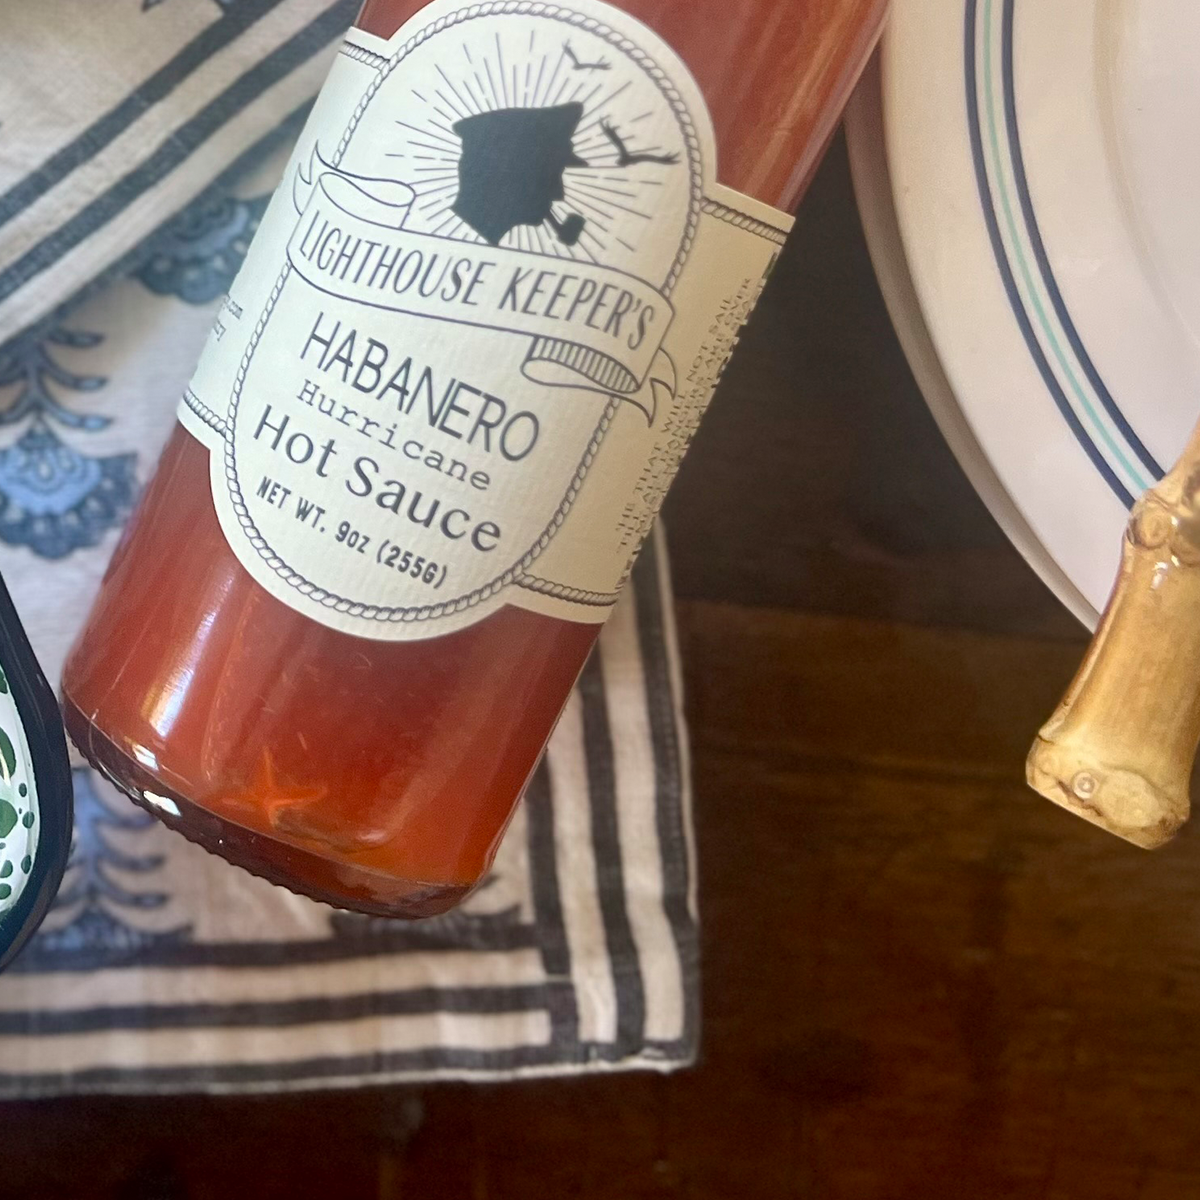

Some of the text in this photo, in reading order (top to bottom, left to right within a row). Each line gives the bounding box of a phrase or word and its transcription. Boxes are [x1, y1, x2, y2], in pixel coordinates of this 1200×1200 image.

[299, 209, 655, 350] LIGHTHOUSE KEEPER'S
[300, 311, 539, 461] HABANERO
[685, 341, 709, 382] NOT
[253, 404, 501, 552] Hot Sauce
[296, 379, 491, 490] Hurricane
[256, 476, 291, 508] NET
[295, 497, 325, 533] WT.
[377, 539, 447, 589] (255G)
